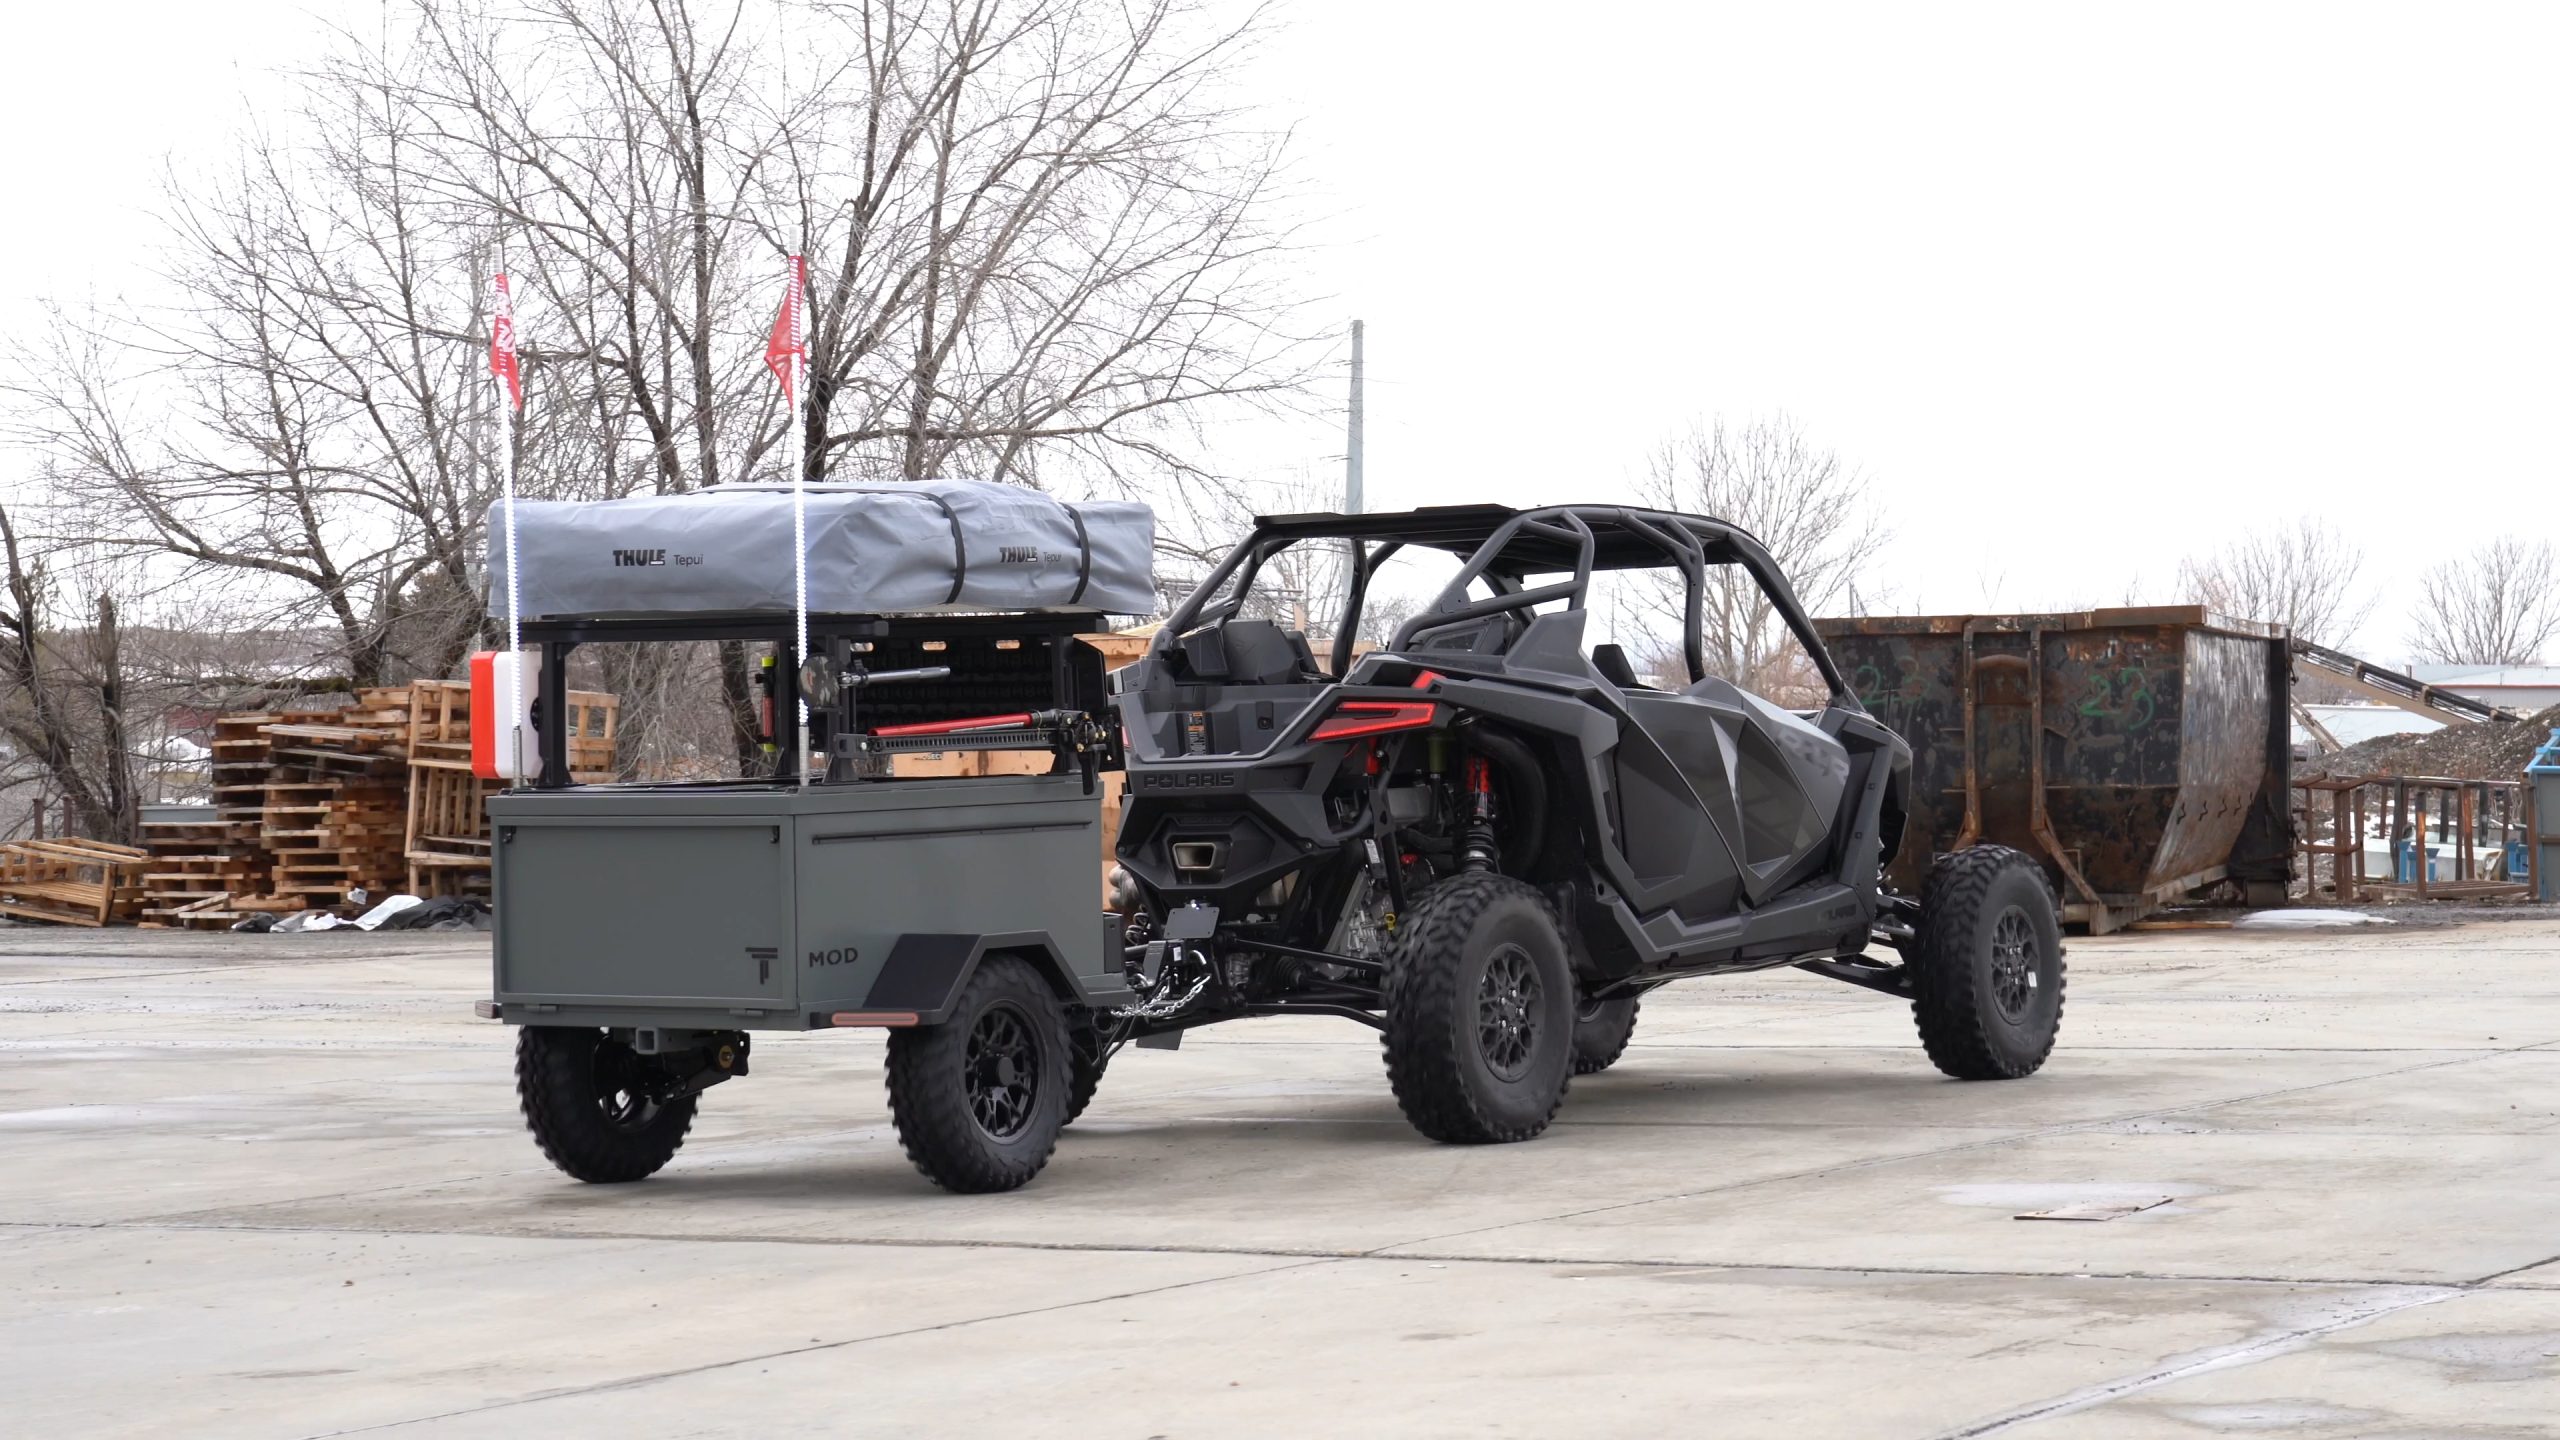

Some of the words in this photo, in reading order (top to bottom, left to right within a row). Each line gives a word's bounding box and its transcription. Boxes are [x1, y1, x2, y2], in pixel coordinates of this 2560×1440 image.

[613, 549, 666, 566] THULE
[673, 554, 704, 567] Tepui
[999, 546, 1038, 562] THULE
[2080, 666, 2155, 731] 23
[1143, 772, 1235, 789] POLARIS
[808, 947, 858, 968] MOD
